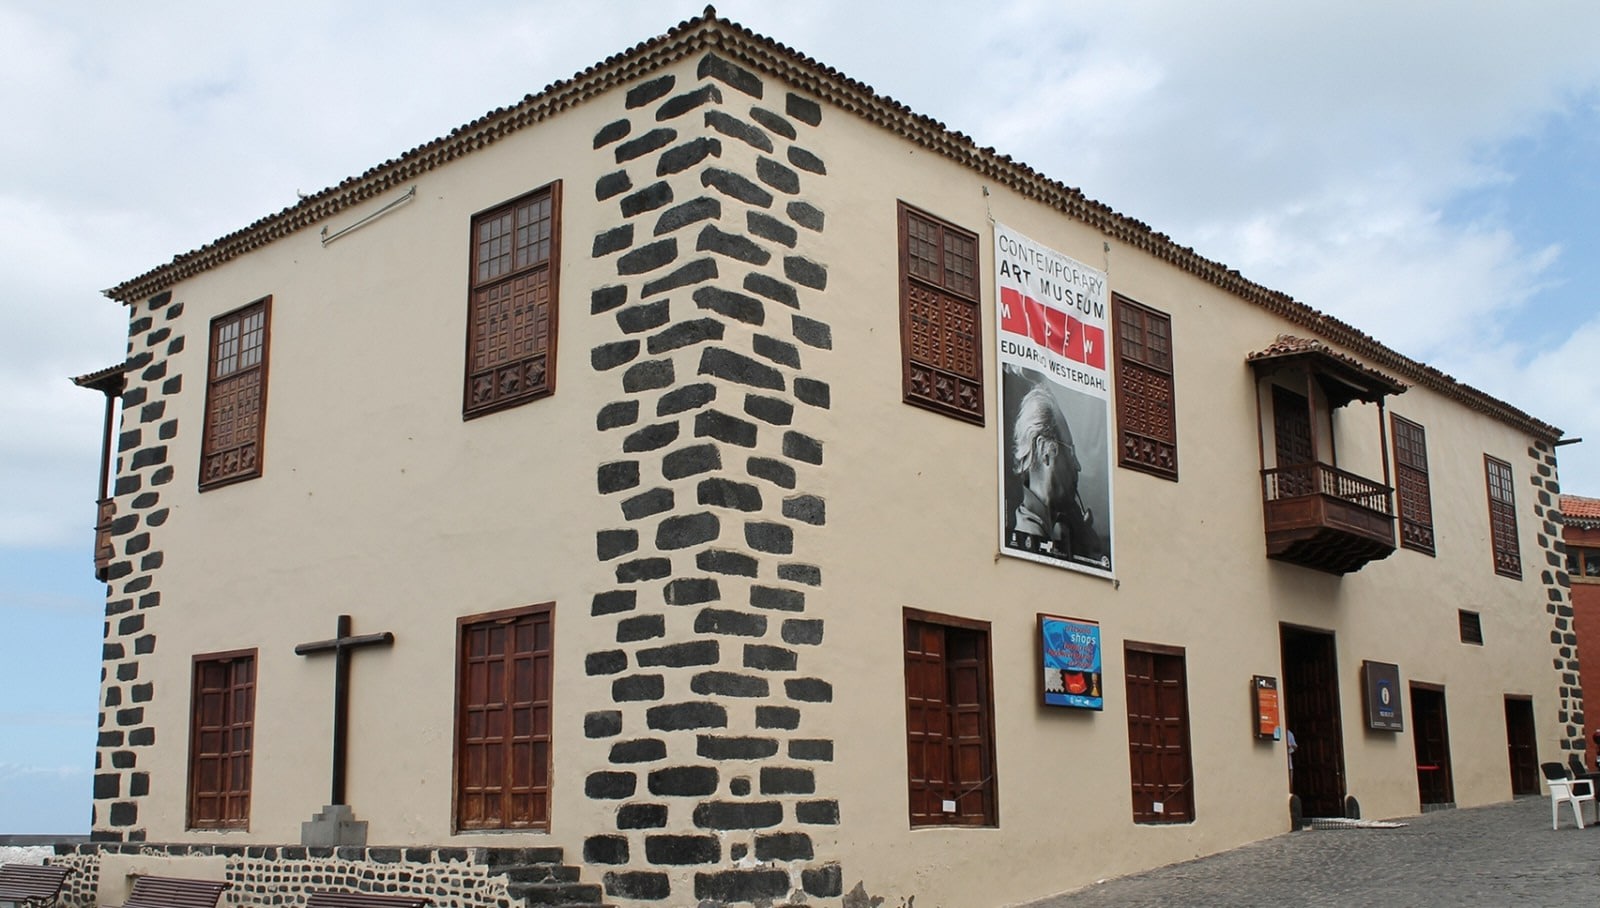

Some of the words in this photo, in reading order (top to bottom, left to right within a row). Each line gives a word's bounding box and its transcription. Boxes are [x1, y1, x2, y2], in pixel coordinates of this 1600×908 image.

[999, 235, 1103, 296] CONTEMPORARY
[1000, 259, 1031, 287] ART
[1040, 278, 1104, 320] MUSEUM
[1001, 340, 1047, 368] EDUARO
[1049, 360, 1107, 392] WESTERDAHL
[1071, 633, 1096, 646] shops
